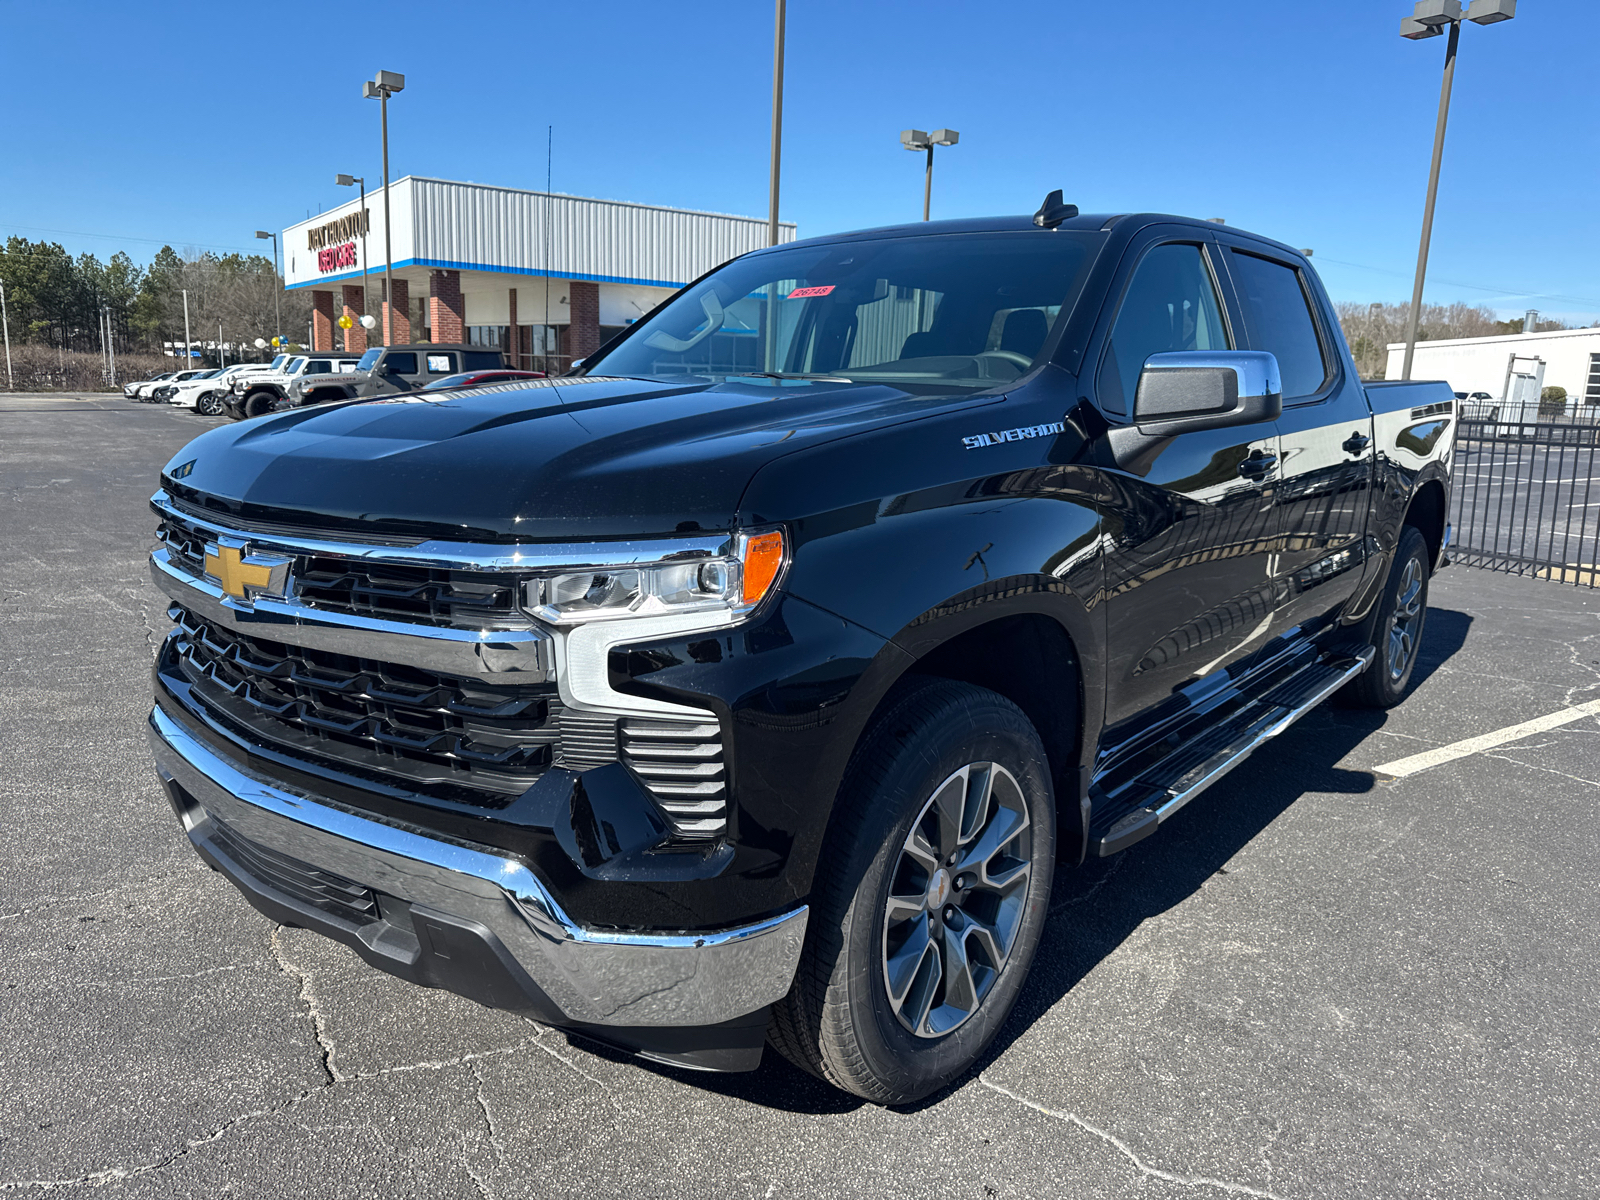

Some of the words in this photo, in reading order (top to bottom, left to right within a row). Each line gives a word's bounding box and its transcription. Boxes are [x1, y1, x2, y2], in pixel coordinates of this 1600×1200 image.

[318, 248, 335, 272] USED
[335, 241, 355, 268] CARS
[794, 287, 828, 297] 26748
[961, 421, 1066, 450] SILVERADO
